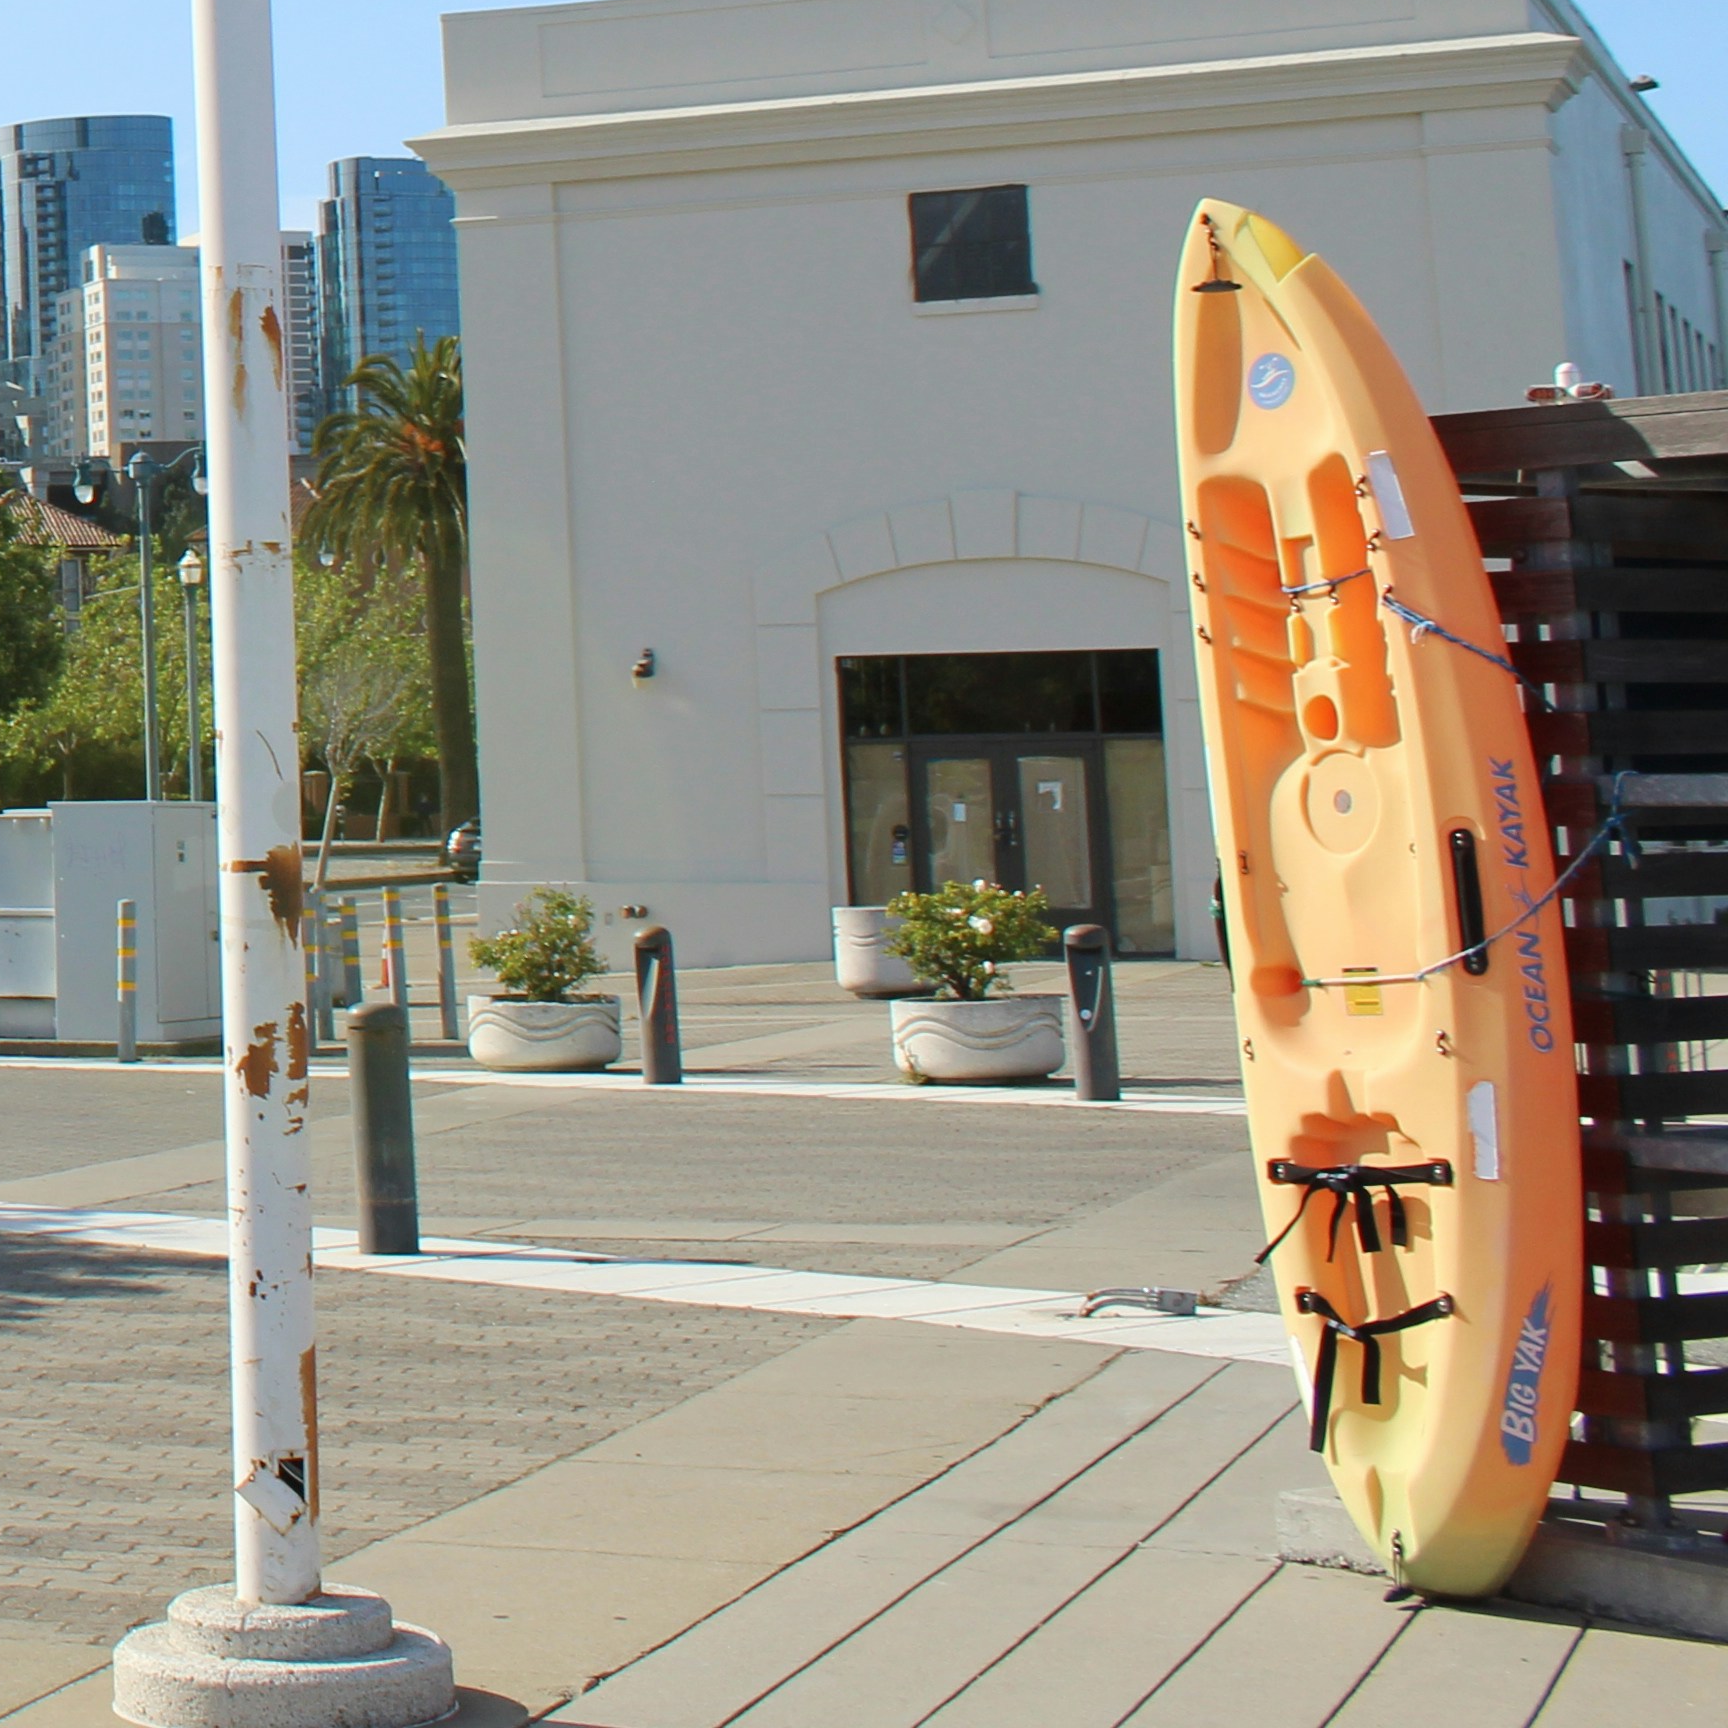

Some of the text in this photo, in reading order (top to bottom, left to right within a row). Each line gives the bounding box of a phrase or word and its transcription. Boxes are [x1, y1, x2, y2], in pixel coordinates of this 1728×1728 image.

[1489, 756, 1555, 1054] OCEAN KAYAK
[1500, 1317, 1547, 1443] BIG YAK
